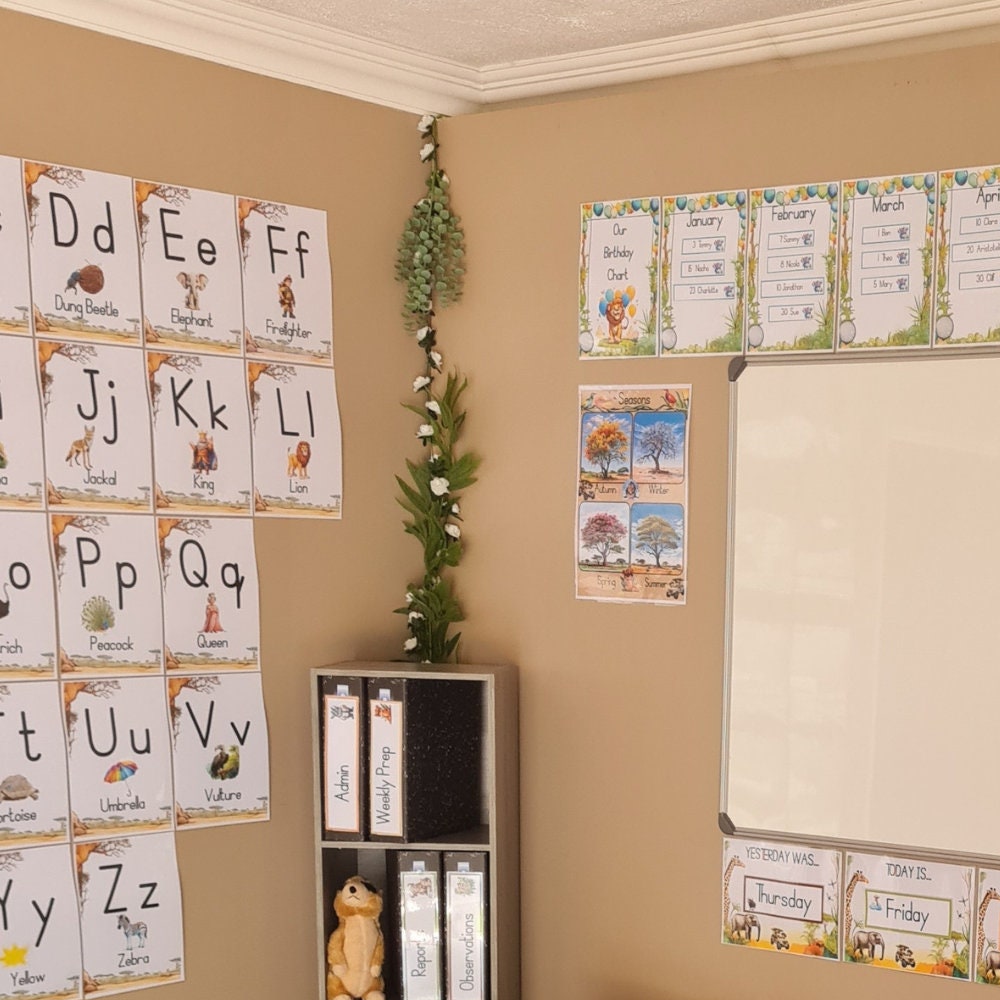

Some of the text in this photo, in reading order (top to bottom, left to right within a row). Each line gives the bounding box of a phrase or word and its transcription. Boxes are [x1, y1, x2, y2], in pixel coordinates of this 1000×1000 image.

[872, 195, 904, 213] March
[686, 211, 723, 231] January
[771, 205, 817, 224] February
[613, 223, 627, 236] Our
[603, 246, 634, 262] Birthday
[607, 268, 629, 281] Chart
[54, 294, 119, 319] Dung Beetle
[171, 308, 214, 329] Elephant
[265, 318, 312, 343] Firefighter
[618, 391, 651, 405] Seasons
[83, 470, 117, 486] Jackal
[193, 473, 215, 494] King
[289, 478, 309, 494] Lion
[594, 483, 617, 494] Autumn
[648, 483, 669, 495] Winter
[644, 577, 668, 588] Summer
[89, 635, 134, 651] Peacock
[196, 633, 229, 649] Queen
[334, 764, 350, 803] Admin
[376, 745, 397, 826] Weekly Prep
[204, 787, 242, 802] Vulture
[99, 797, 146, 813] Umbrella
[745, 846, 792, 865] YESTERDAY
[886, 862, 915, 879] TODAY
[755, 882, 812, 918] Thursday
[886, 897, 930, 932] Friday
[117, 952, 150, 968] Zebra
[410, 929, 433, 977] Repor
[459, 913, 475, 992] Observations
[10, 970, 46, 987] Yellow
